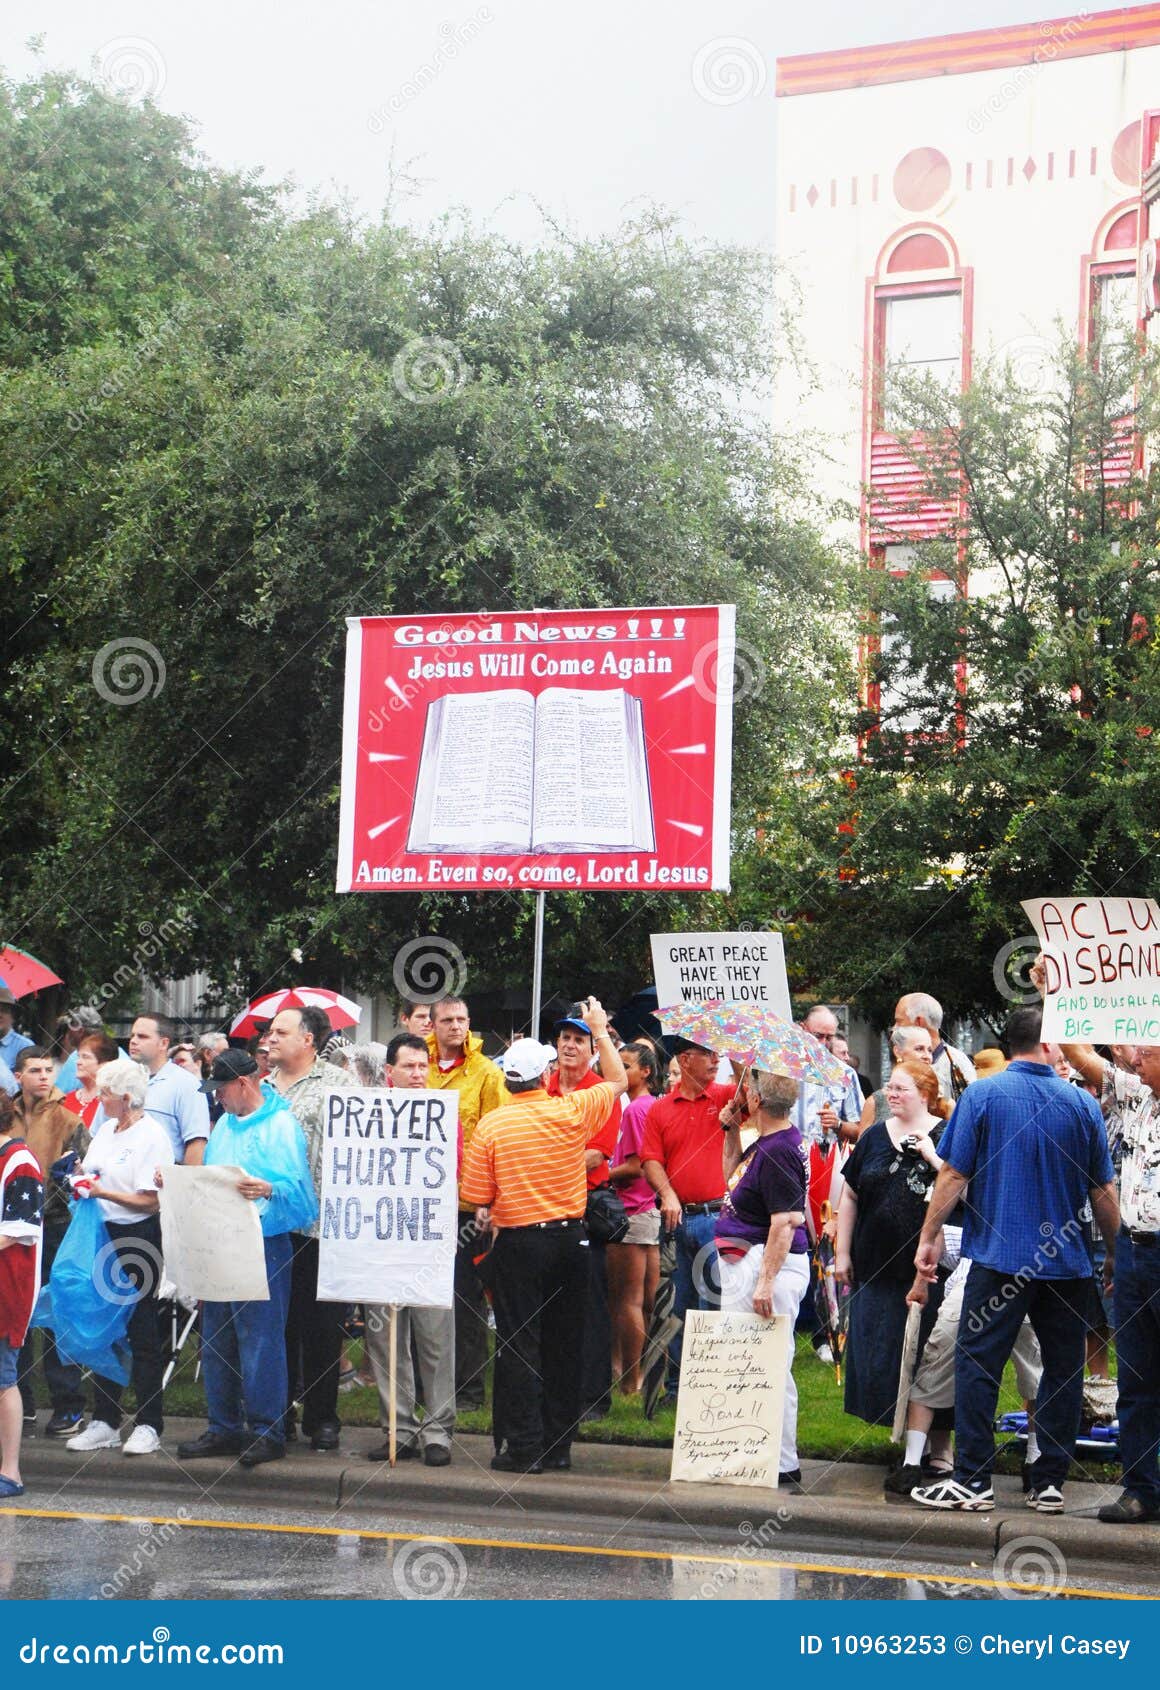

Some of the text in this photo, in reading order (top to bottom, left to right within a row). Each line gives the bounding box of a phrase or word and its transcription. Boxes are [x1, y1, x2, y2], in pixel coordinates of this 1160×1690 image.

[394, 622, 503, 646] Good
[513, 622, 617, 642] News
[407, 650, 672, 680] Jesus Will Come Again
[355, 859, 709, 886] Amen. Even so, come, Lord Jesus
[1041, 899, 1159, 942] ACLU
[669, 946, 769, 963] GREAT PEACE
[680, 966, 760, 982] HAVE THEY
[680, 986, 769, 1001] WHICH LOVE
[1056, 996, 1088, 1012] AND
[1127, 994, 1148, 1008] ALL
[1064, 1018, 1095, 1038] BIG
[328, 1095, 448, 1143] PRAYER
[332, 1146, 447, 1190] HURTS
[322, 1196, 444, 1241] NO-ONE
